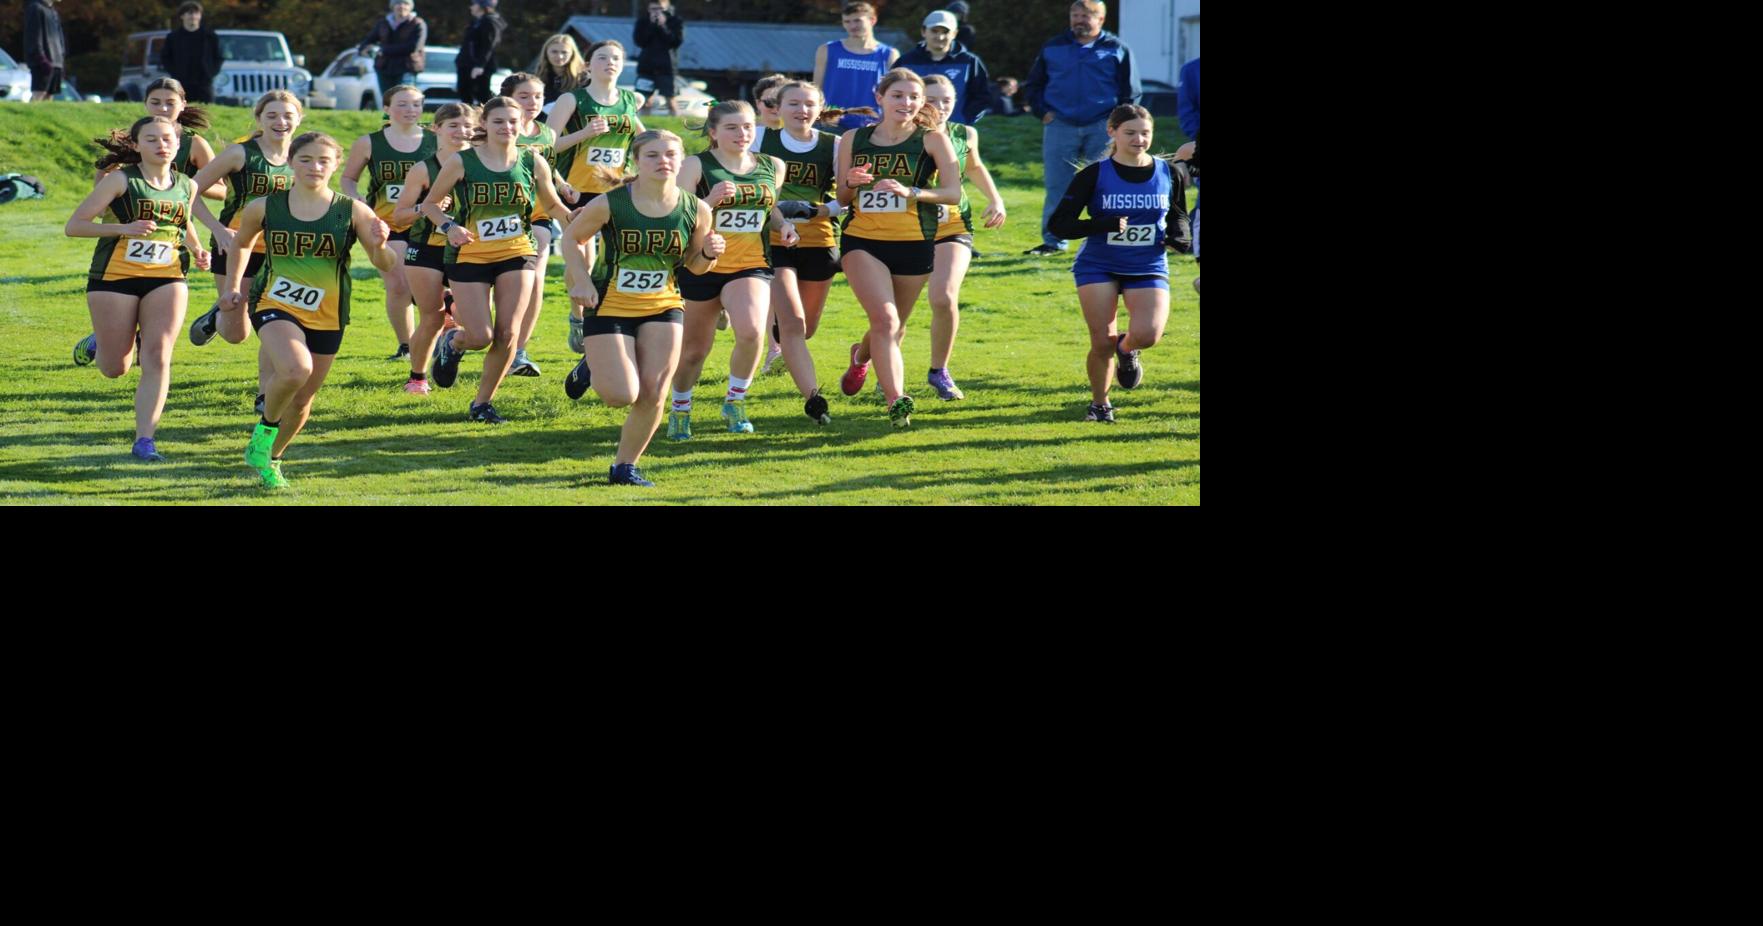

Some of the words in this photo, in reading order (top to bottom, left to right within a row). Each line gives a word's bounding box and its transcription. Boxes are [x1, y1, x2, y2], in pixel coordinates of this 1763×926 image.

[585, 114, 633, 134] FA
[590, 148, 621, 163] 253
[381, 160, 415, 181] BF
[783, 161, 818, 186] FA
[252, 173, 294, 196] BF
[472, 182, 527, 206] BFA
[138, 198, 186, 225] BFA
[863, 192, 899, 209] 251
[482, 216, 519, 238] 245
[720, 211, 759, 228] 254
[129, 241, 169, 260] 247
[271, 230, 337, 258] BFA
[621, 229, 683, 257] BFA
[621, 271, 664, 289] 252
[273, 280, 319, 306] 240
